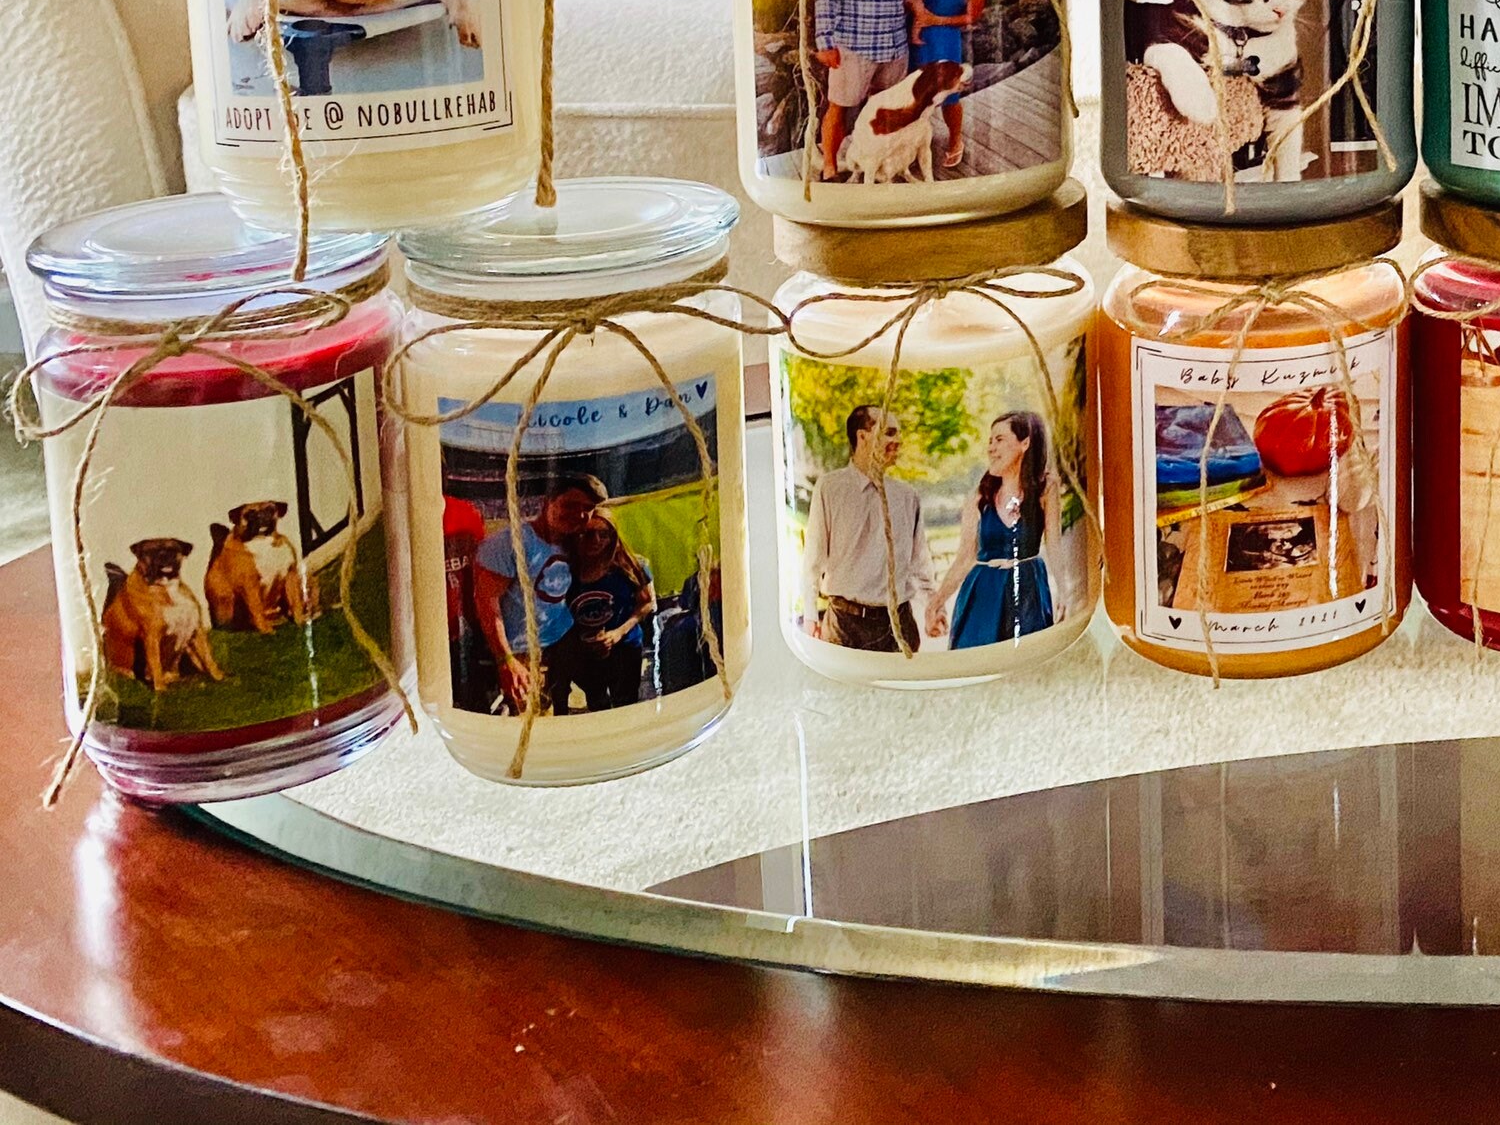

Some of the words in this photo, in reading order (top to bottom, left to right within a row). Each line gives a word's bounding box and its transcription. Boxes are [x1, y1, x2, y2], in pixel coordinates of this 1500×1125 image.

[226, 106, 272, 131] ADOPT
[324, 101, 344, 131] @
[357, 90, 496, 127] NOBULLREHAB
[1260, 356, 1361, 386] Kuzmik
[618, 404, 628, 419] &
[1208, 618, 1279, 633] March
